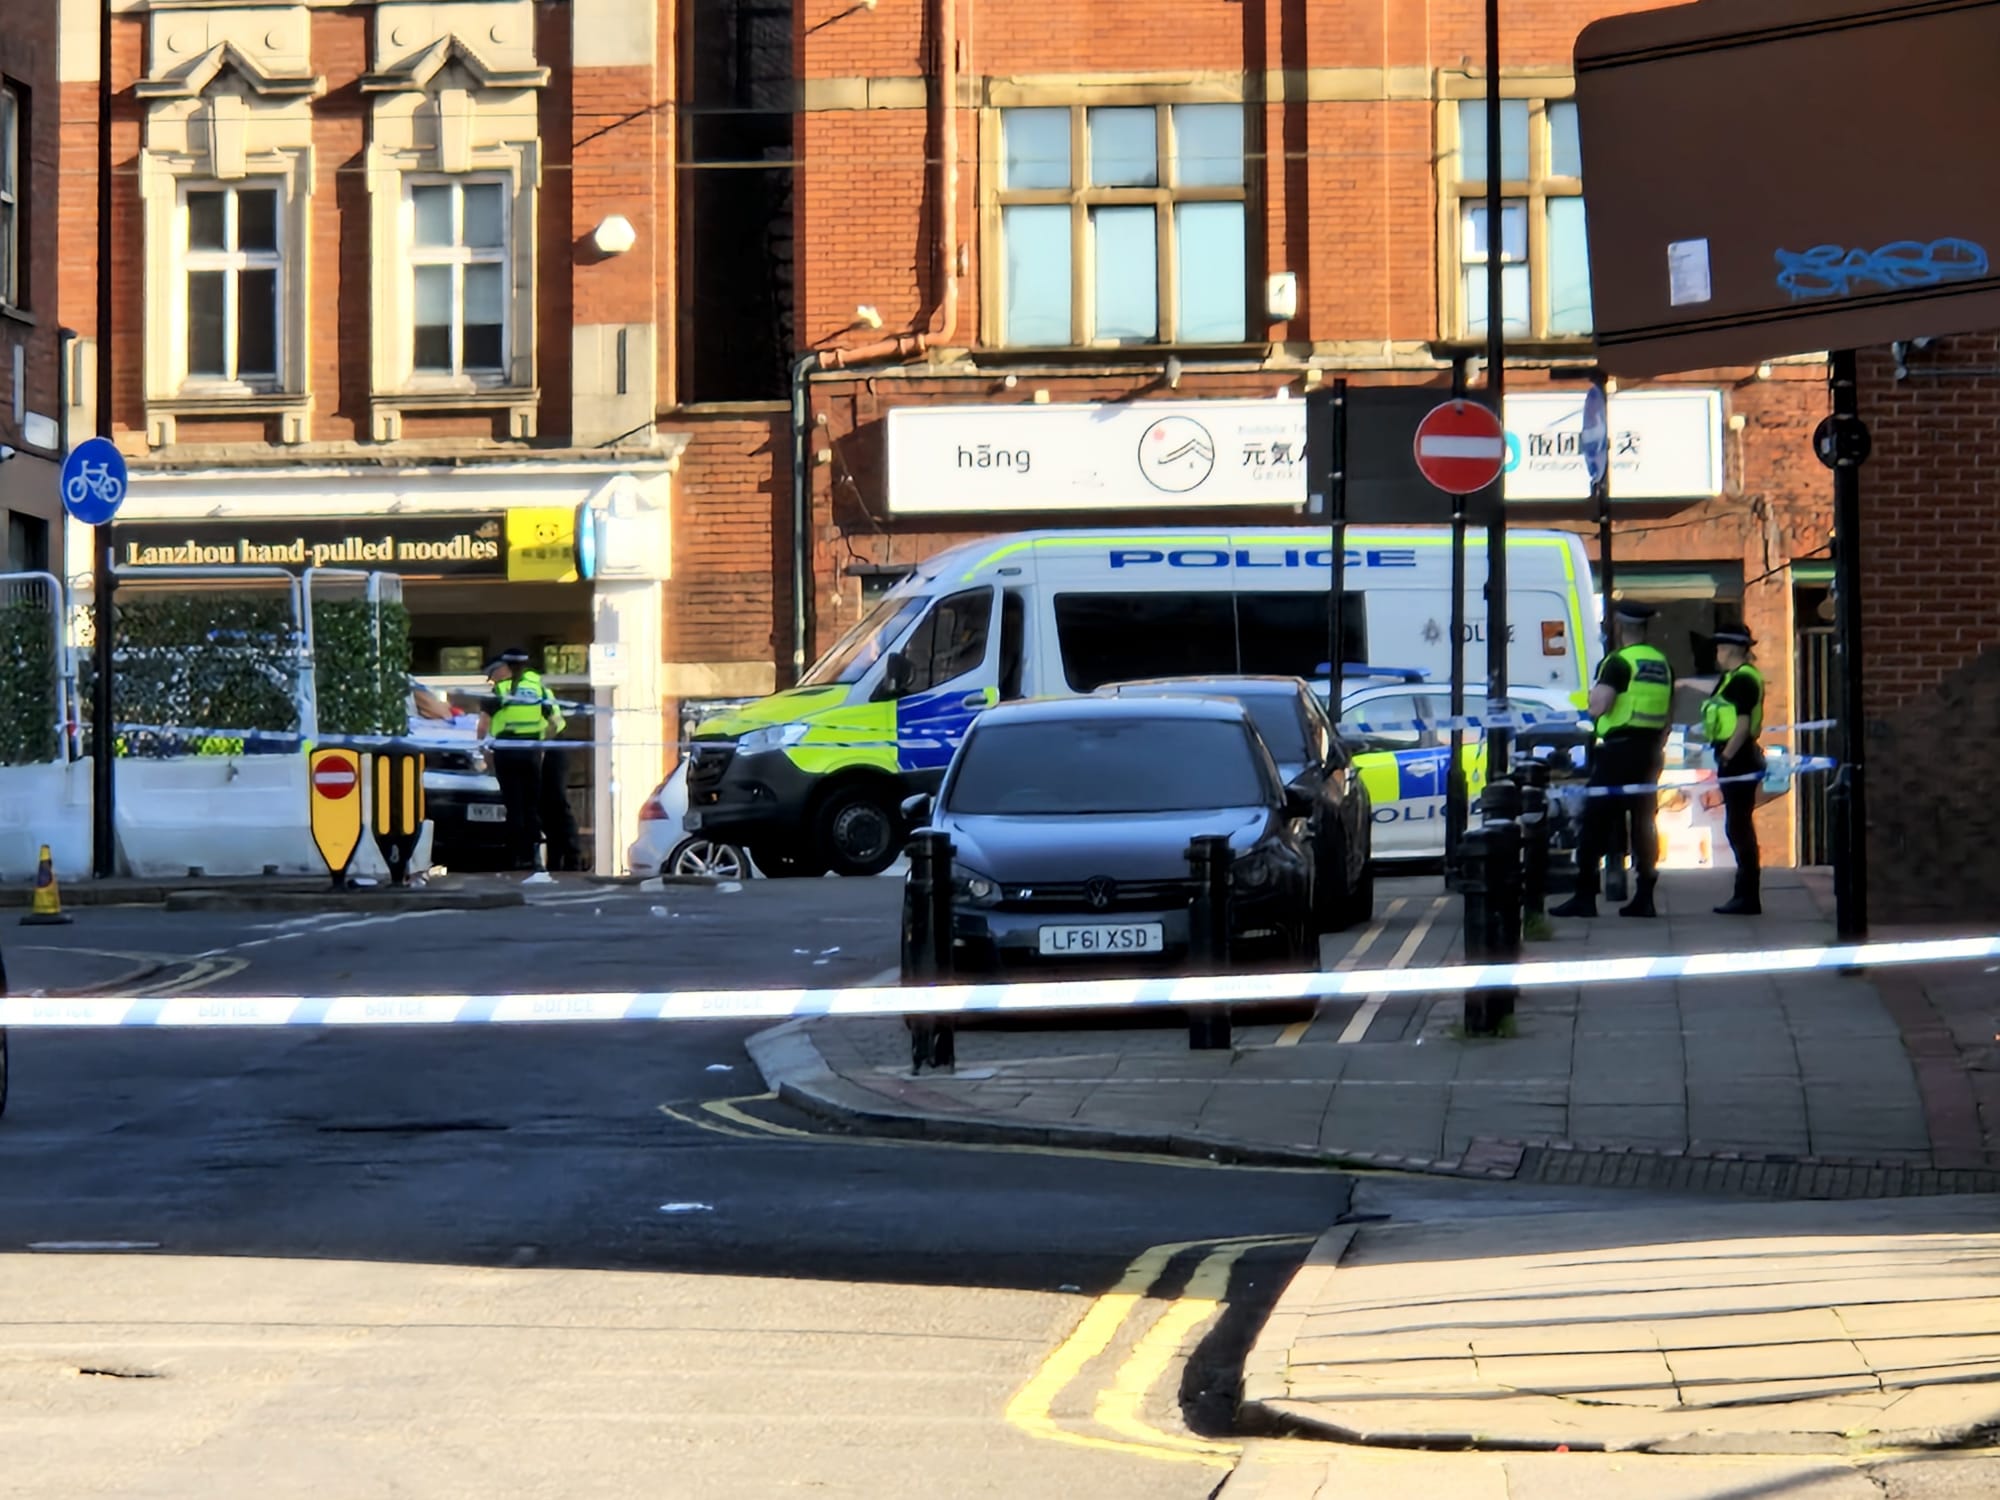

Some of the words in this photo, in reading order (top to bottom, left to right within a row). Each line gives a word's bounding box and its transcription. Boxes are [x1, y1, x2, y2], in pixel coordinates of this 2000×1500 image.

[958, 444, 1030, 473] hāng
[128, 540, 235, 565] Lanzhou
[239, 535, 393, 567] hand-pulled
[400, 535, 498, 560] noodles
[1110, 550, 1416, 568] POLICE
[1053, 930, 1099, 950] LF61
[1107, 928, 1147, 949] XSD
